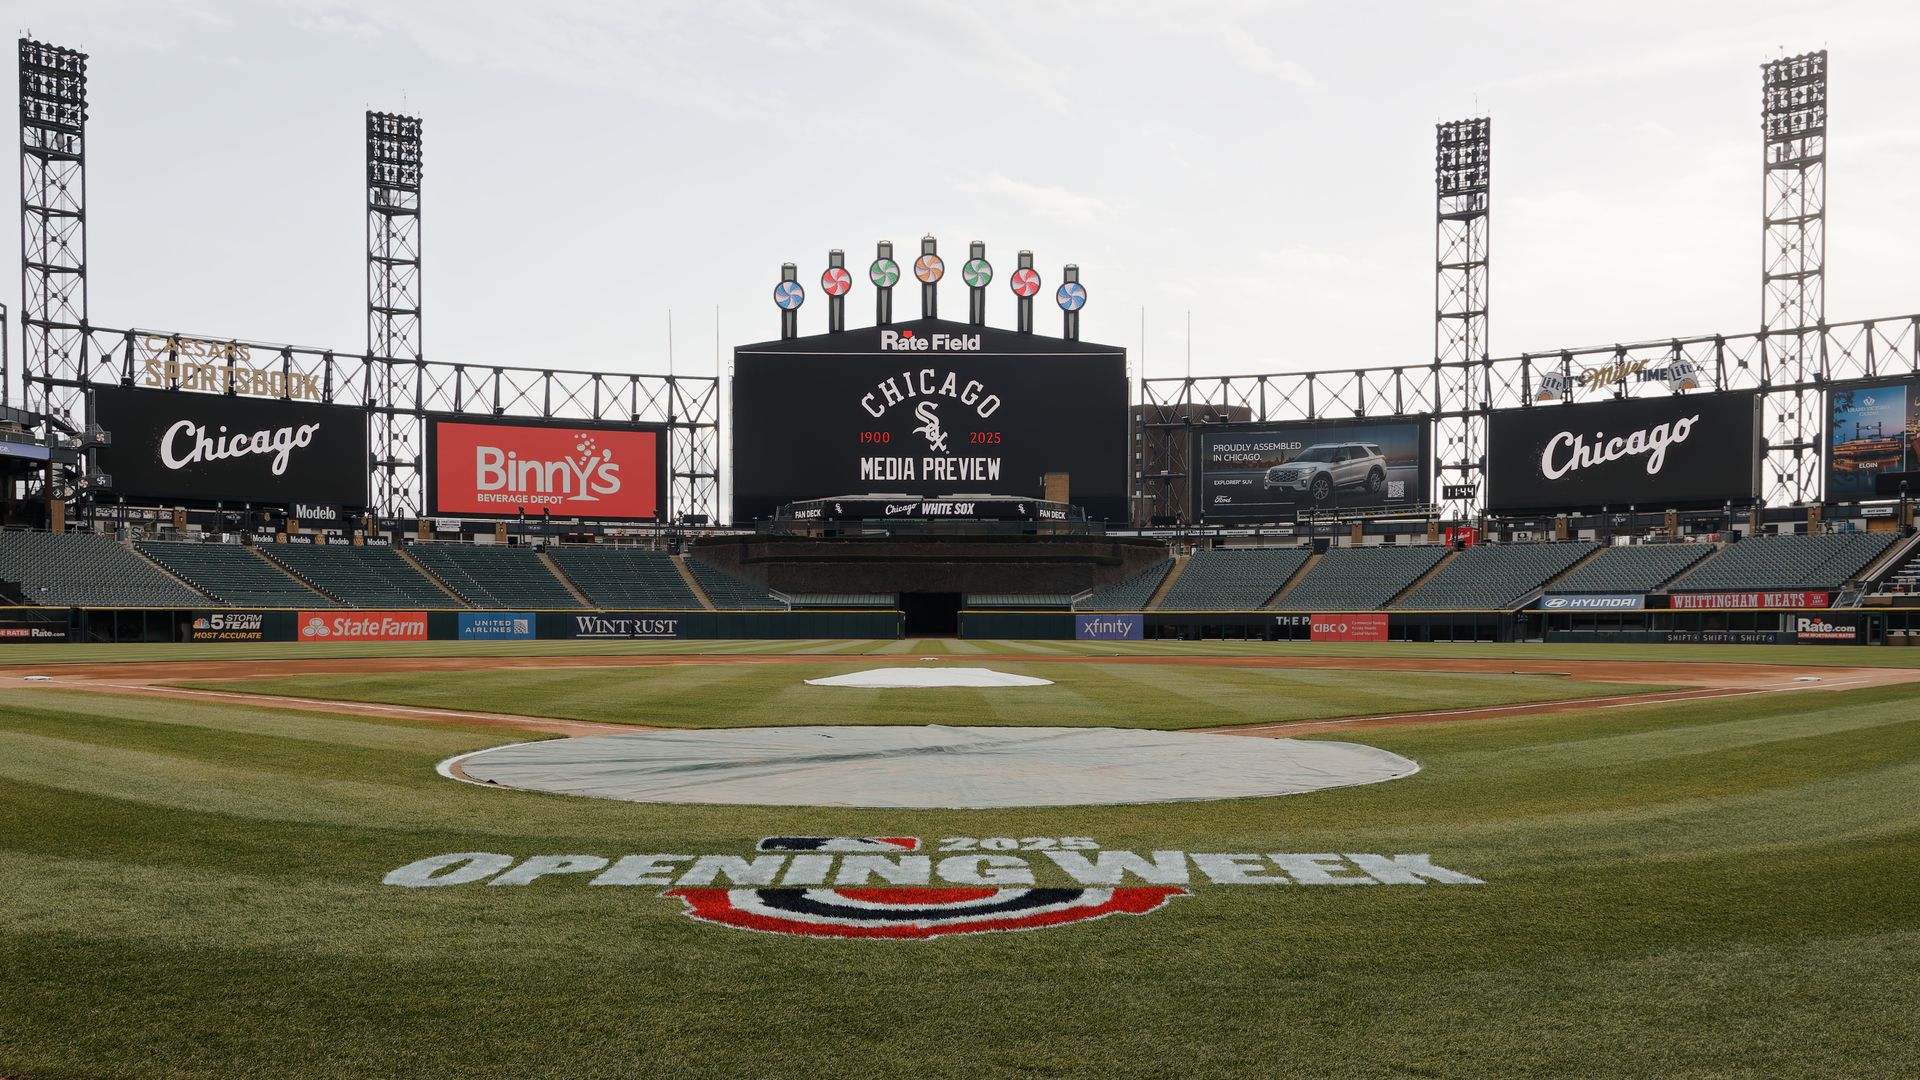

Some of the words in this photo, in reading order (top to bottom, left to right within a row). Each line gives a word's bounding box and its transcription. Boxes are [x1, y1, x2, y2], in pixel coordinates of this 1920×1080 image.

[881, 330, 929, 351] Rate
[932, 334, 981, 351] Field
[145, 336, 251, 361] CAESARS
[1580, 359, 1650, 393] Miller
[1635, 368, 1668, 383] TIME
[1671, 362, 1693, 381] Lite
[145, 359, 321, 401] SPORTSBOOK
[1541, 376, 1562, 391] Lite
[861, 368, 1001, 418] CHICAGO
[860, 431, 891, 444] 1900
[970, 432, 1001, 444] 2025
[160, 419, 320, 476] Chicago
[1213, 443, 1252, 452] PROUDLY
[1253, 442, 1302, 451] ASSEMBLED
[1541, 414, 1700, 480] Chicago
[1223, 453, 1262, 462] CHICAGO.
[861, 457, 915, 481] MEDIA
[923, 457, 1001, 481] PREVIEW
[1447, 487, 1474, 497] 11:44
[477, 494, 529, 503] BEVERAGE
[530, 496, 564, 504] DEPOT
[1214, 495, 1232, 504] Ford
[296, 504, 336, 520] Modelo
[795, 510, 806, 519] FAN
[806, 508, 822, 518] DECK
[885, 503, 916, 516] Chicago
[921, 502, 953, 515] WHITE
[953, 502, 975, 515] SOX
[1039, 509, 1051, 518] FAN
[1051, 510, 1066, 520] DECK
[252, 534, 274, 543] Modelo
[290, 535, 311, 544] Modelo
[328, 537, 350, 545] Modelo
[366, 538, 388, 546] Modelo
[1570, 598, 1636, 607] HYUNDAI
[1673, 594, 1759, 609] WHITTINGHAM
[1764, 593, 1805, 607] MEATS
[210, 614, 224, 630] 5
[225, 614, 263, 623] STORM
[576, 616, 678, 634] WINTRUST
[1275, 616, 1299, 626] THE
[1798, 618, 1856, 632] Rate.com
[224, 621, 261, 630] TEAM
[1084, 619, 1133, 637] xfinity
[1313, 623, 1336, 633] CIBC
[31, 628, 66, 637] Rate.com
[193, 632, 218, 640] MOST
[218, 632, 262, 640] ACCURATE
[938, 836, 1101, 851] 2025
[382, 851, 1036, 887] OPENING
[1044, 850, 1486, 885] WEEK
